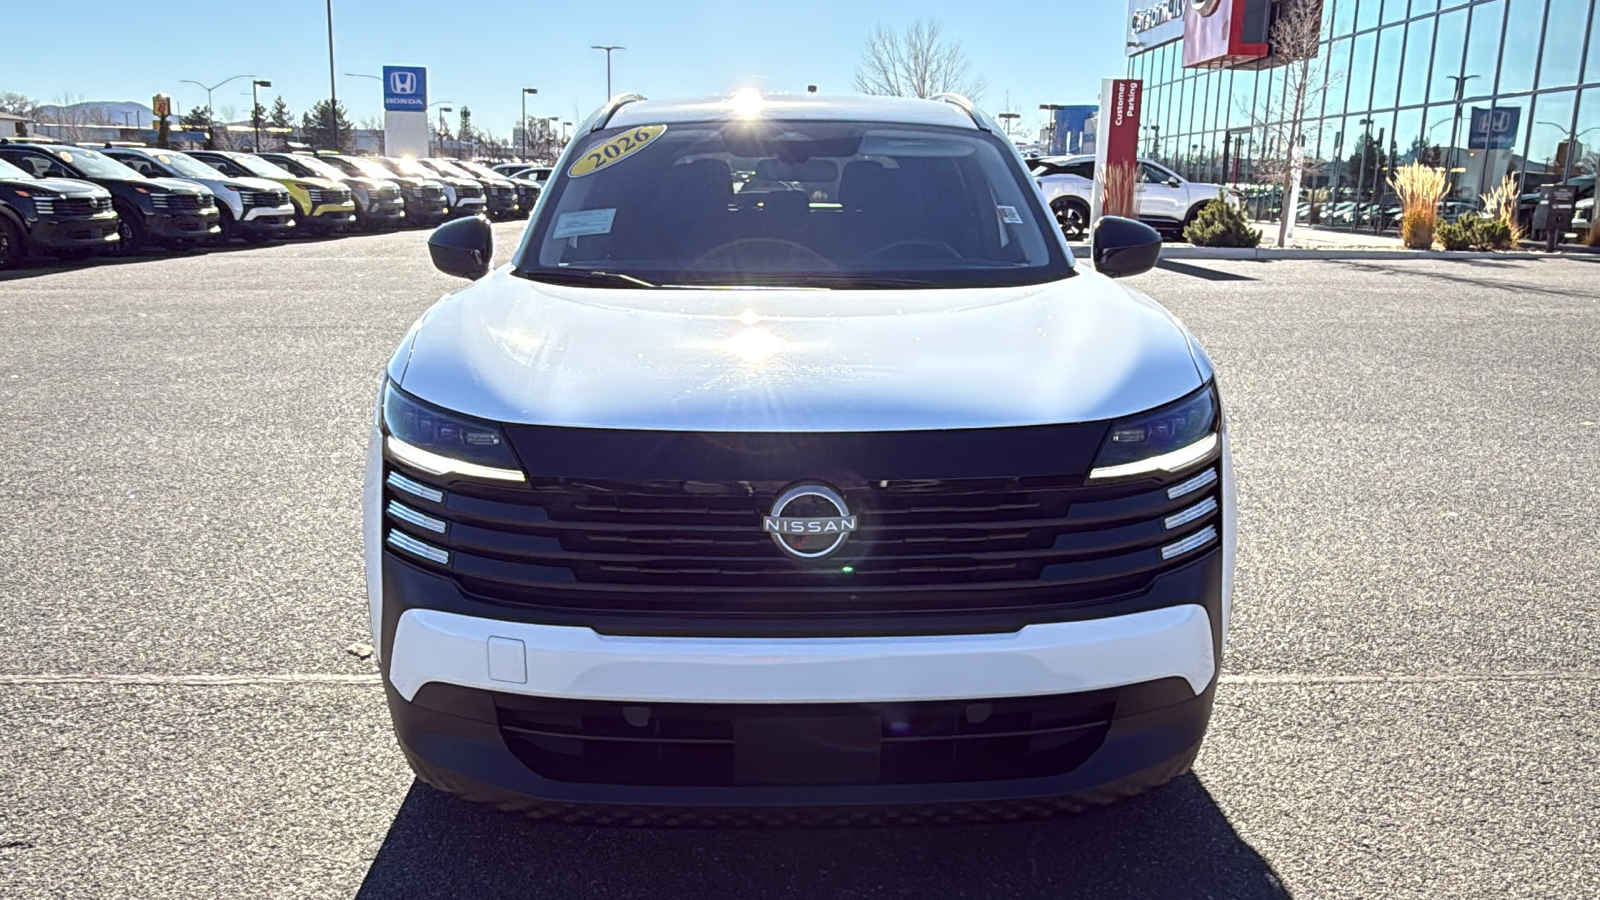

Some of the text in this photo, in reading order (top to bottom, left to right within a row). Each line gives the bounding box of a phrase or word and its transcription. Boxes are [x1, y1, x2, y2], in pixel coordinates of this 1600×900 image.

[1115, 82, 1125, 126] Customer
[1126, 82, 1138, 117] Parking
[588, 129, 650, 169] 2026
[765, 518, 855, 533] NISSAN
